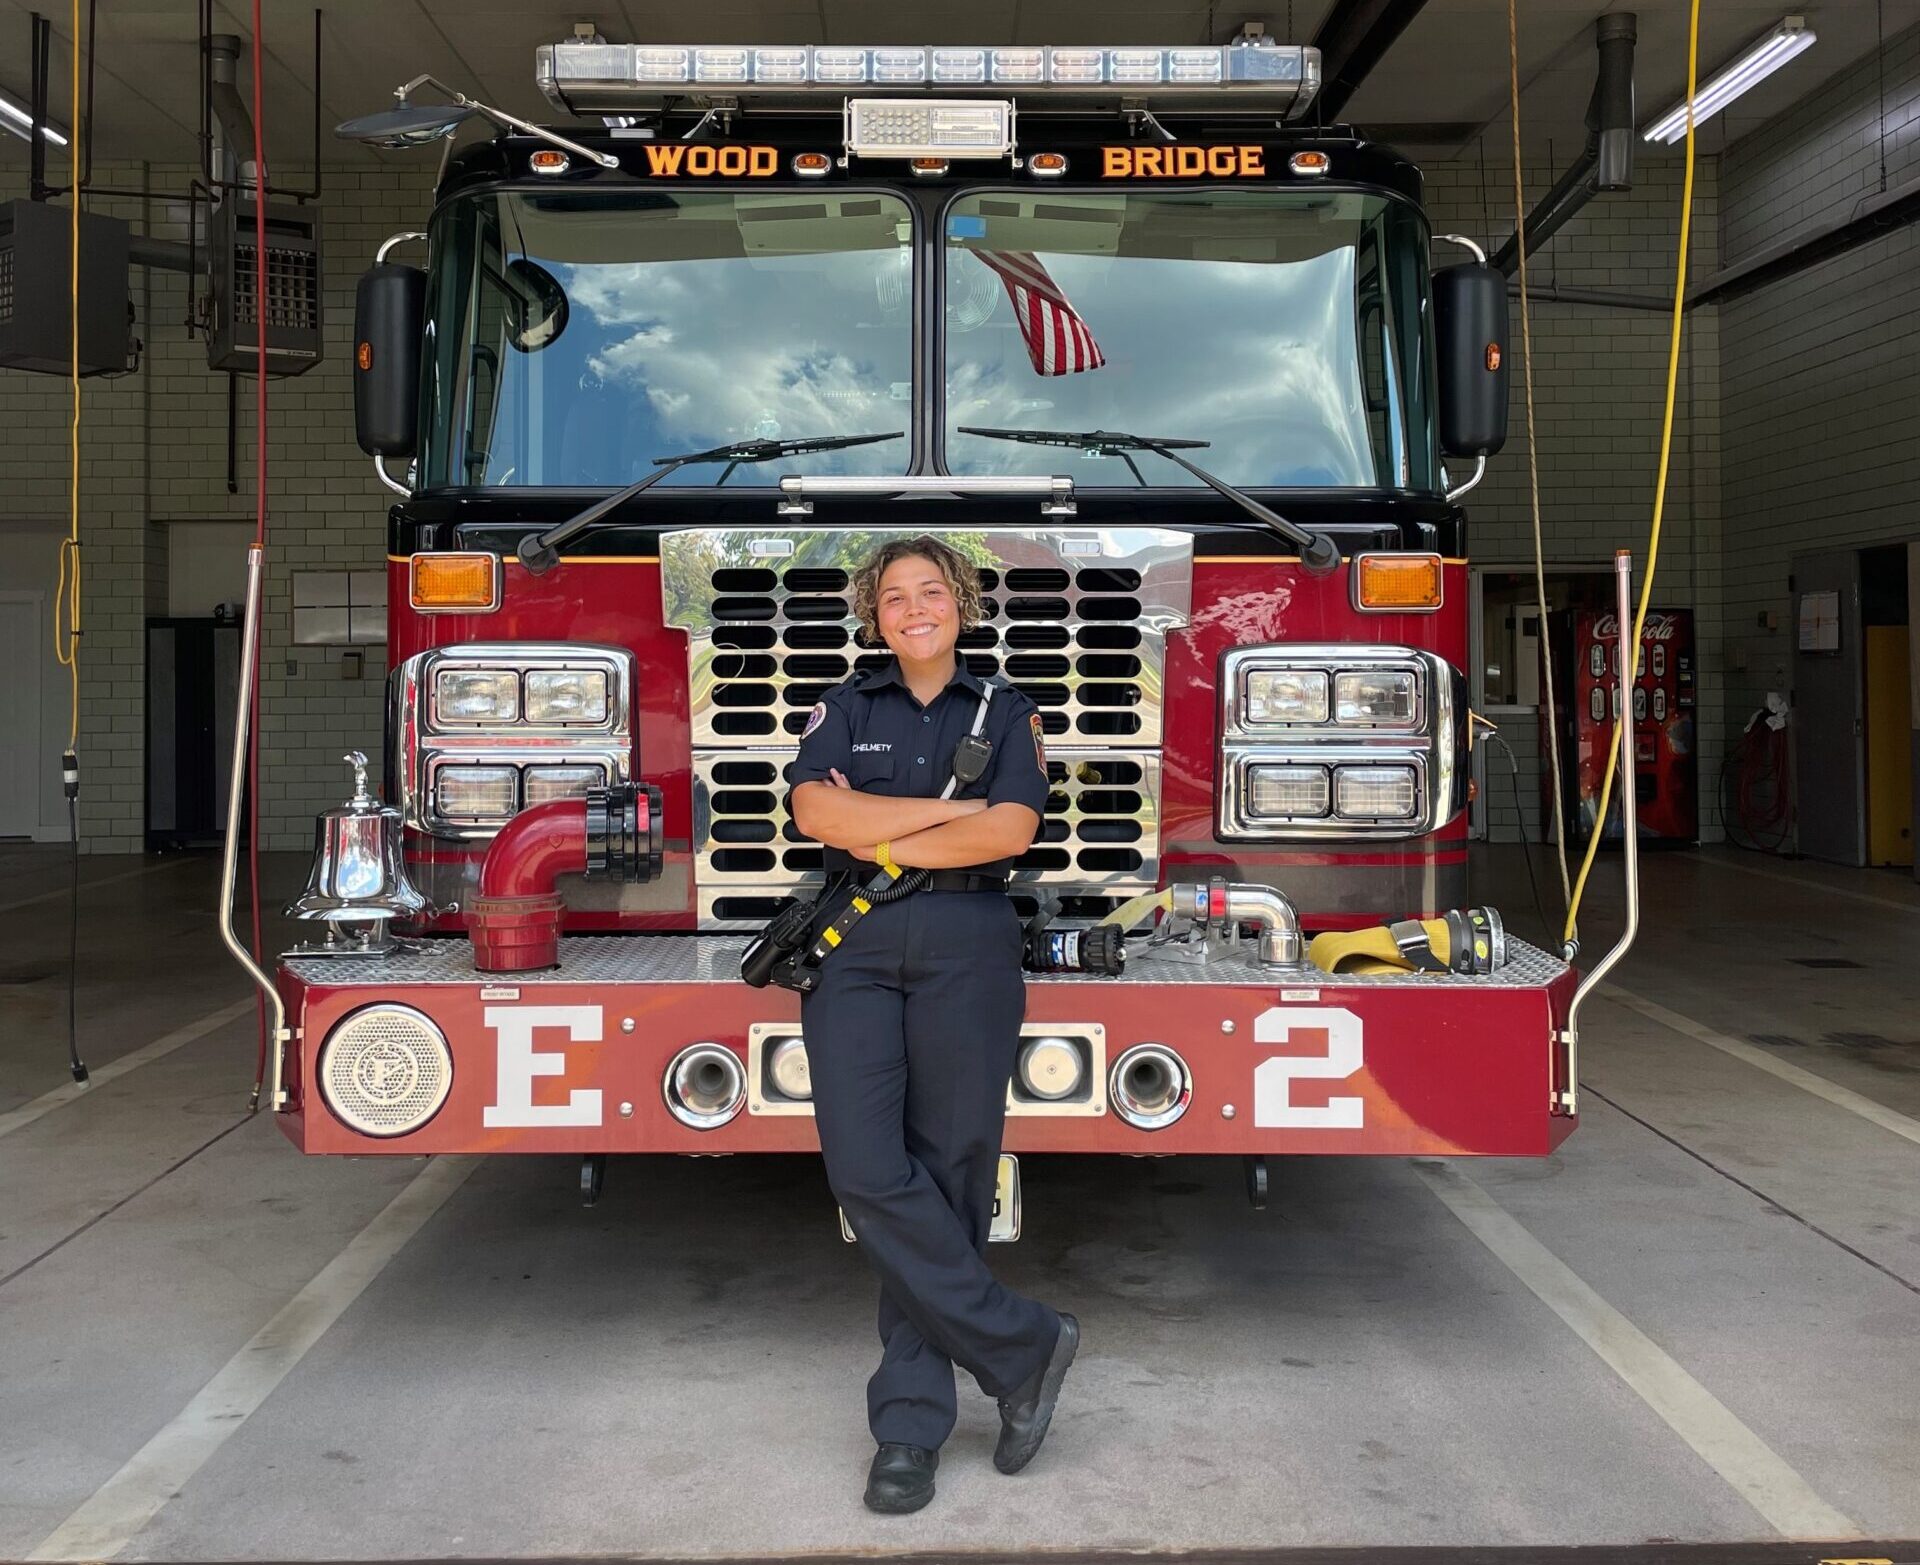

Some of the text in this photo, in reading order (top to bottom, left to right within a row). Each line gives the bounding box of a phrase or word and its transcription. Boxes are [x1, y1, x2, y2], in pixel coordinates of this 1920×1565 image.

[643, 146, 1266, 177] WOOD BRIDGE
[1592, 614, 1677, 640] Cocola
[483, 1005, 1363, 1128] E 2
